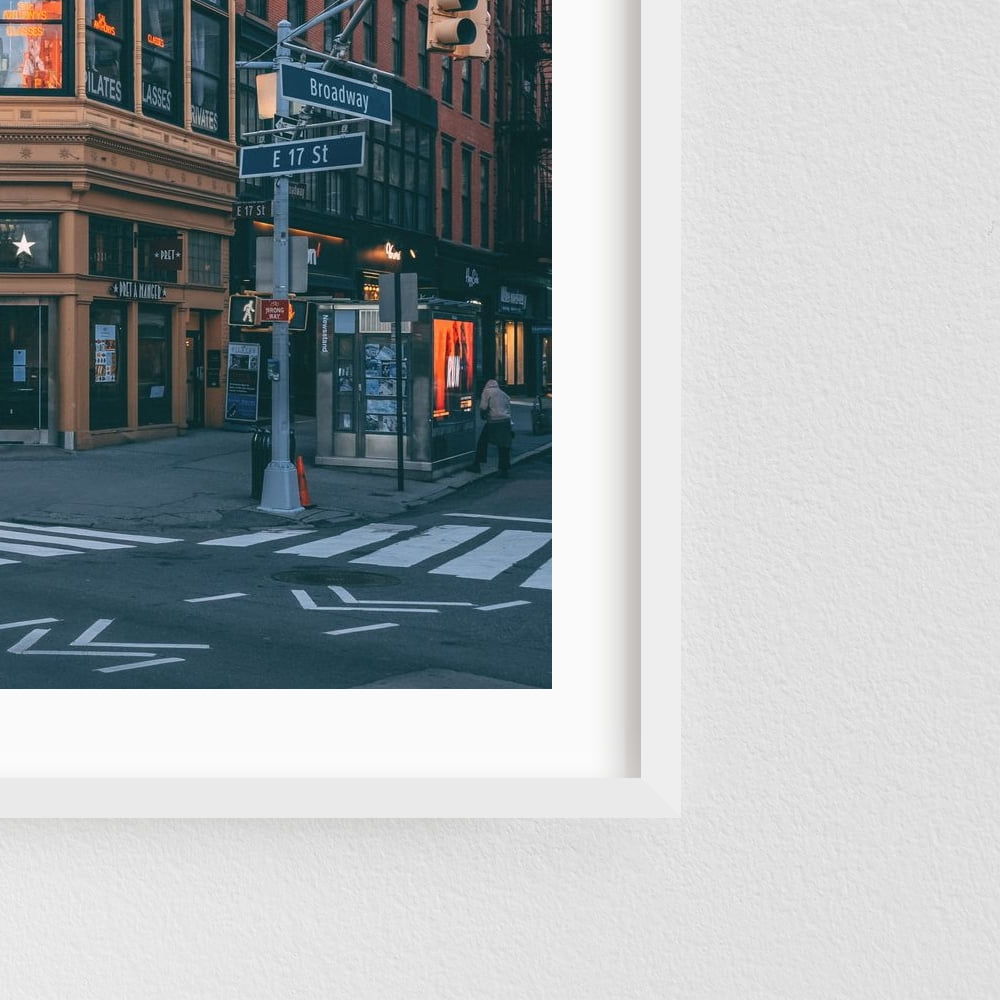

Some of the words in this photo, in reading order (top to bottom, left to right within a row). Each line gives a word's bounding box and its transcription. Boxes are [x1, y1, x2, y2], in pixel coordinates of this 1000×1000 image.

[142, 81, 173, 112] LASSES
[310, 78, 369, 114] Broadway
[191, 104, 218, 131] RIVATES
[273, 150, 281, 168] E
[288, 147, 305, 167] 17
[312, 145, 329, 164] St
[236, 207, 242, 217] E
[245, 206, 253, 217] 17
[256, 204, 265, 216] St
[160, 250, 175, 261] PRET
[120, 281, 132, 297] PRET
[265, 307, 284, 315] WRONG
[321, 314, 329, 353] Newsstand
